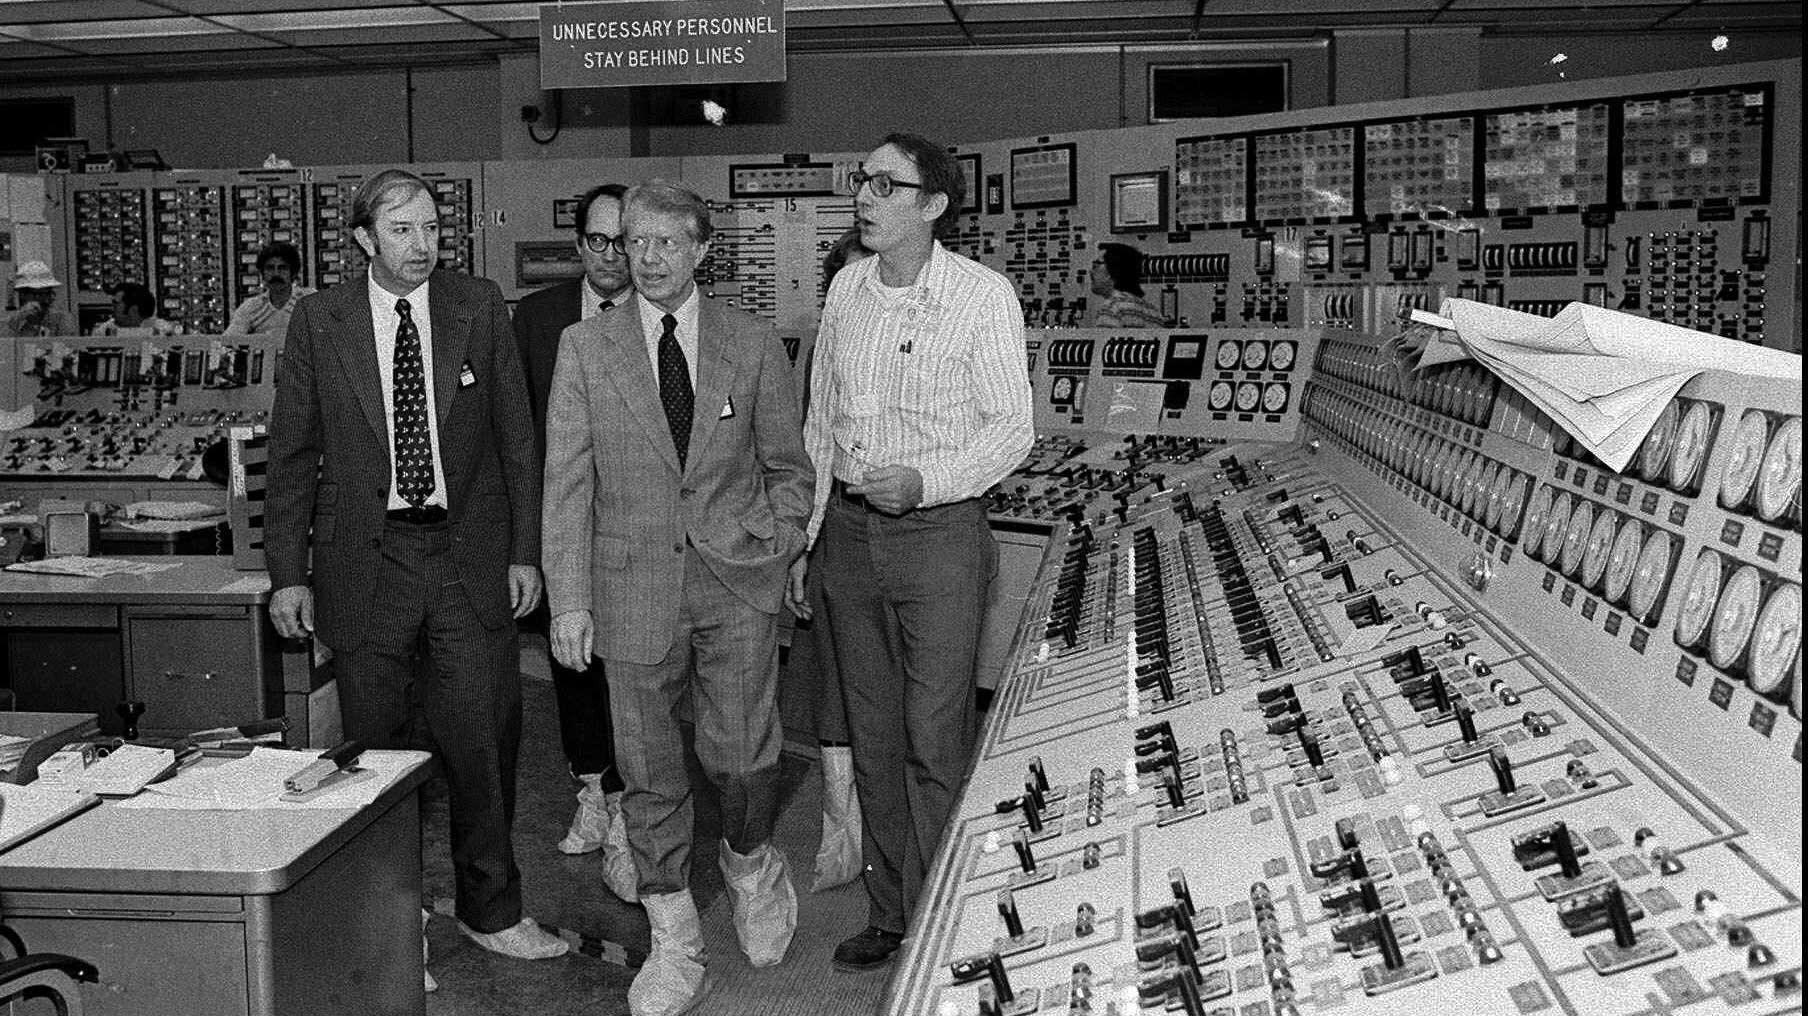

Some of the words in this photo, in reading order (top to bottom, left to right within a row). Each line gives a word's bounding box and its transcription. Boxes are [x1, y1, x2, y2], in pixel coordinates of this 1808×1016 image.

[552, 19, 673, 41] UNNECESSARY
[676, 16, 778, 37] PERSONNEL
[583, 51, 625, 69] STAY
[628, 49, 689, 67] BEHIND
[695, 46, 745, 65] LINES
[784, 198, 797, 212] 15
[494, 210, 506, 226] 14
[1286, 226, 1297, 241] 17
